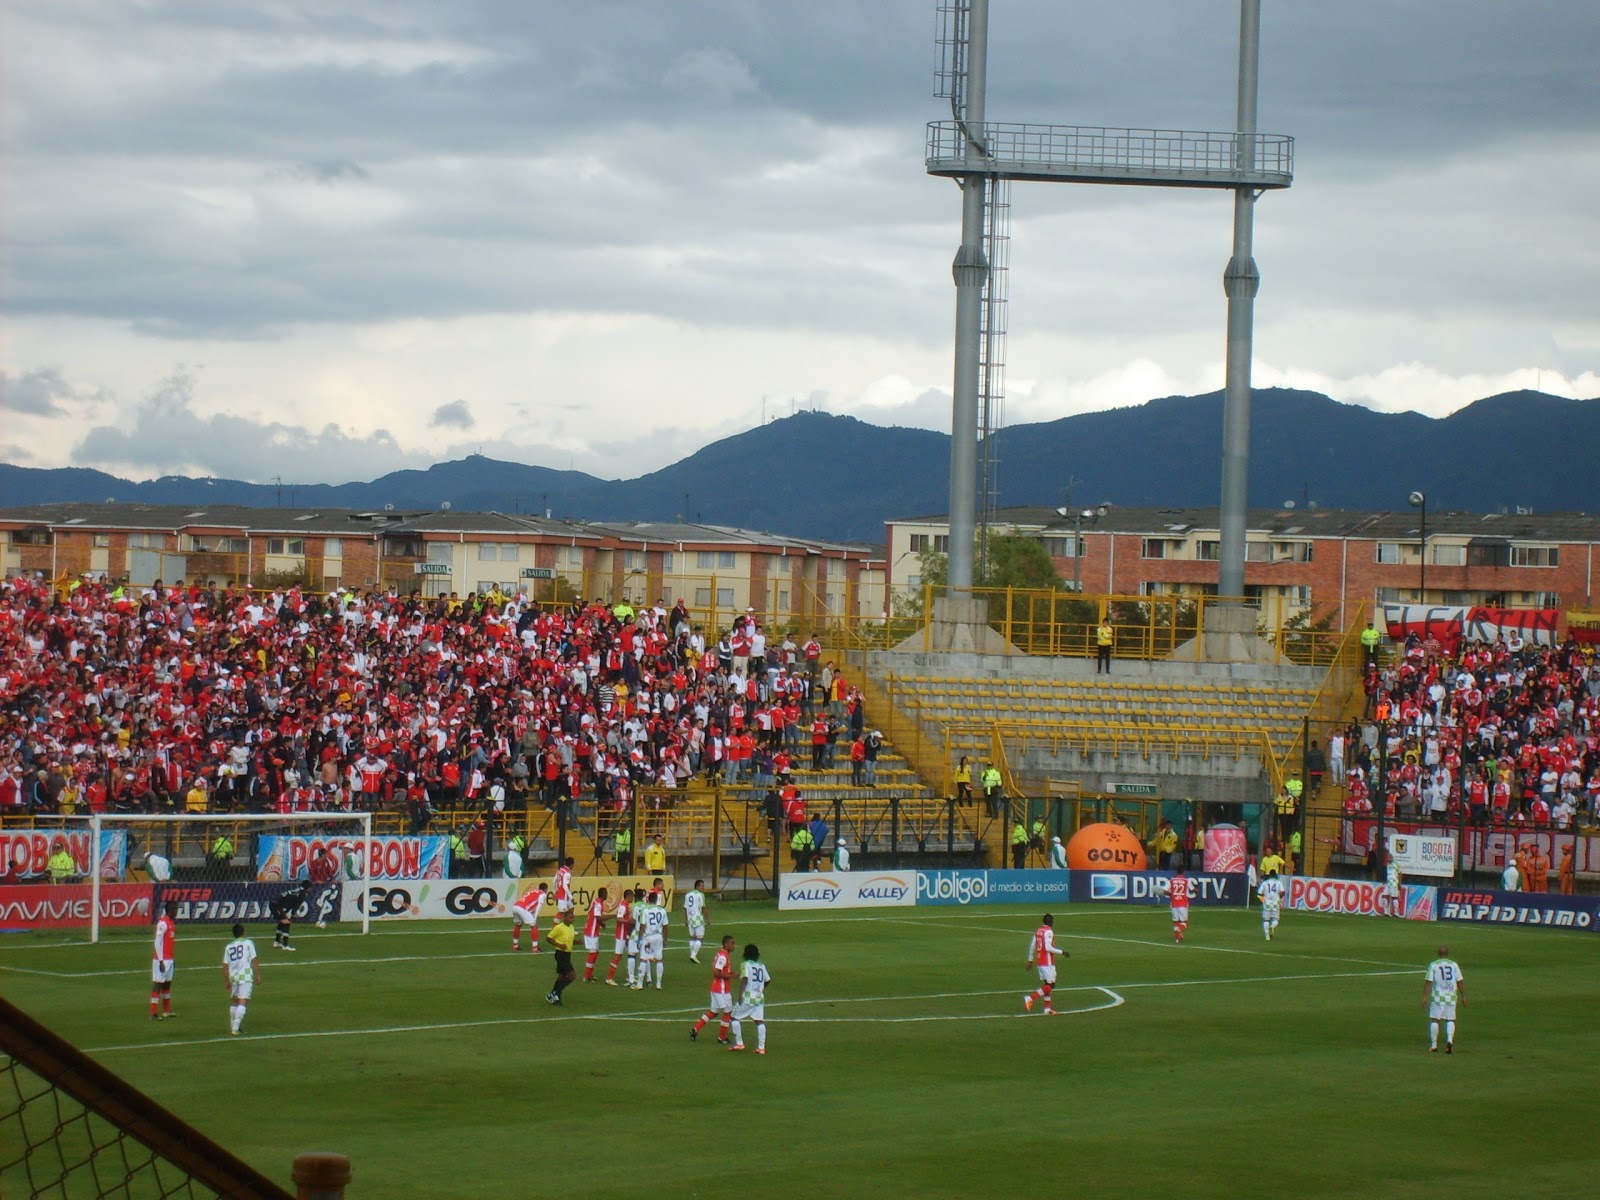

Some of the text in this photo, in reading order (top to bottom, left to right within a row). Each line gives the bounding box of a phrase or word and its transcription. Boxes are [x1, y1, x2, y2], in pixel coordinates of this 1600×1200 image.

[422, 565, 447, 574] SALIDA
[527, 570, 550, 578] SALIDA
[1121, 785, 1151, 793] SALIDA
[1422, 841, 1453, 855] BOGOTÁ
[1087, 848, 1138, 865] GOLTY
[161, 888, 213, 901] INTER
[858, 887, 909, 900] KALLEY
[916, 871, 1068, 904] Publigol el medio de la pasión
[1133, 876, 1227, 900] DIRCTV
[1173, 883, 1185, 896] 22
[1266, 884, 1277, 894] 14
[688, 895, 694, 908] 9
[787, 888, 842, 902] KALLEY
[1445, 892, 1494, 905] INTER
[161, 901, 309, 919] APIDISIO
[1443, 903, 1591, 927] RAPIDISIMO
[649, 911, 662, 926] 20
[229, 945, 243, 962] 28
[751, 966, 763, 983] 30
[1438, 966, 1453, 981] 13
